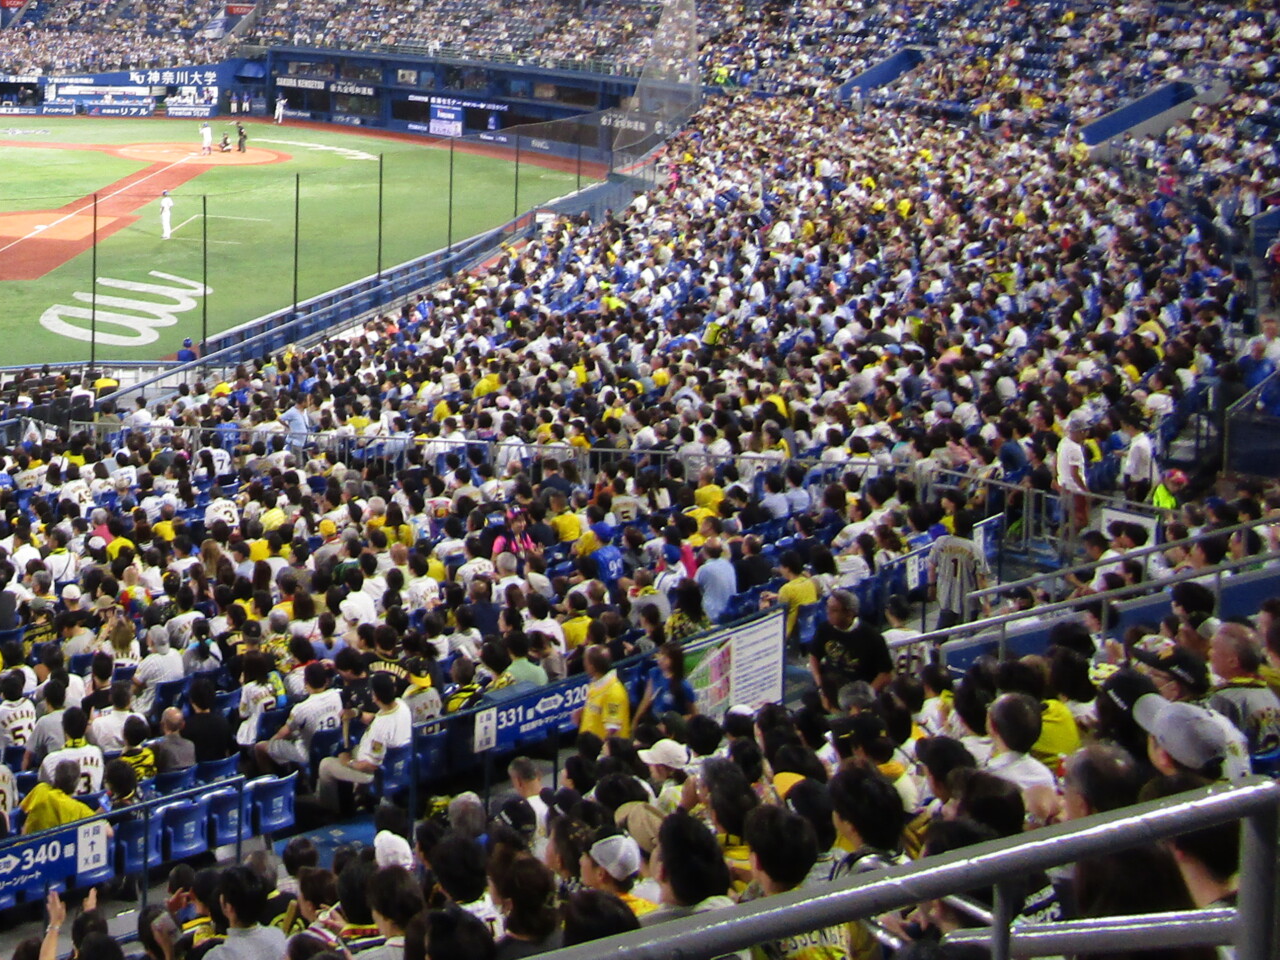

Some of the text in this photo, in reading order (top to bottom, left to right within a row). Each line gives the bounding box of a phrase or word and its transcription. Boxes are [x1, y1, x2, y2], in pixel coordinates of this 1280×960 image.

[146, 70, 218, 86] 神奈川大学
[120, 107, 149, 116] リアル
[216, 459, 224, 470] 7
[223, 509, 236, 524] 3
[951, 558, 958, 578] 1
[564, 683, 589, 708] 320
[415, 699, 442, 714] SATO
[498, 705, 524, 730] 331
[82, 825, 101, 839] H段
[21, 840, 76, 871] 340 番
